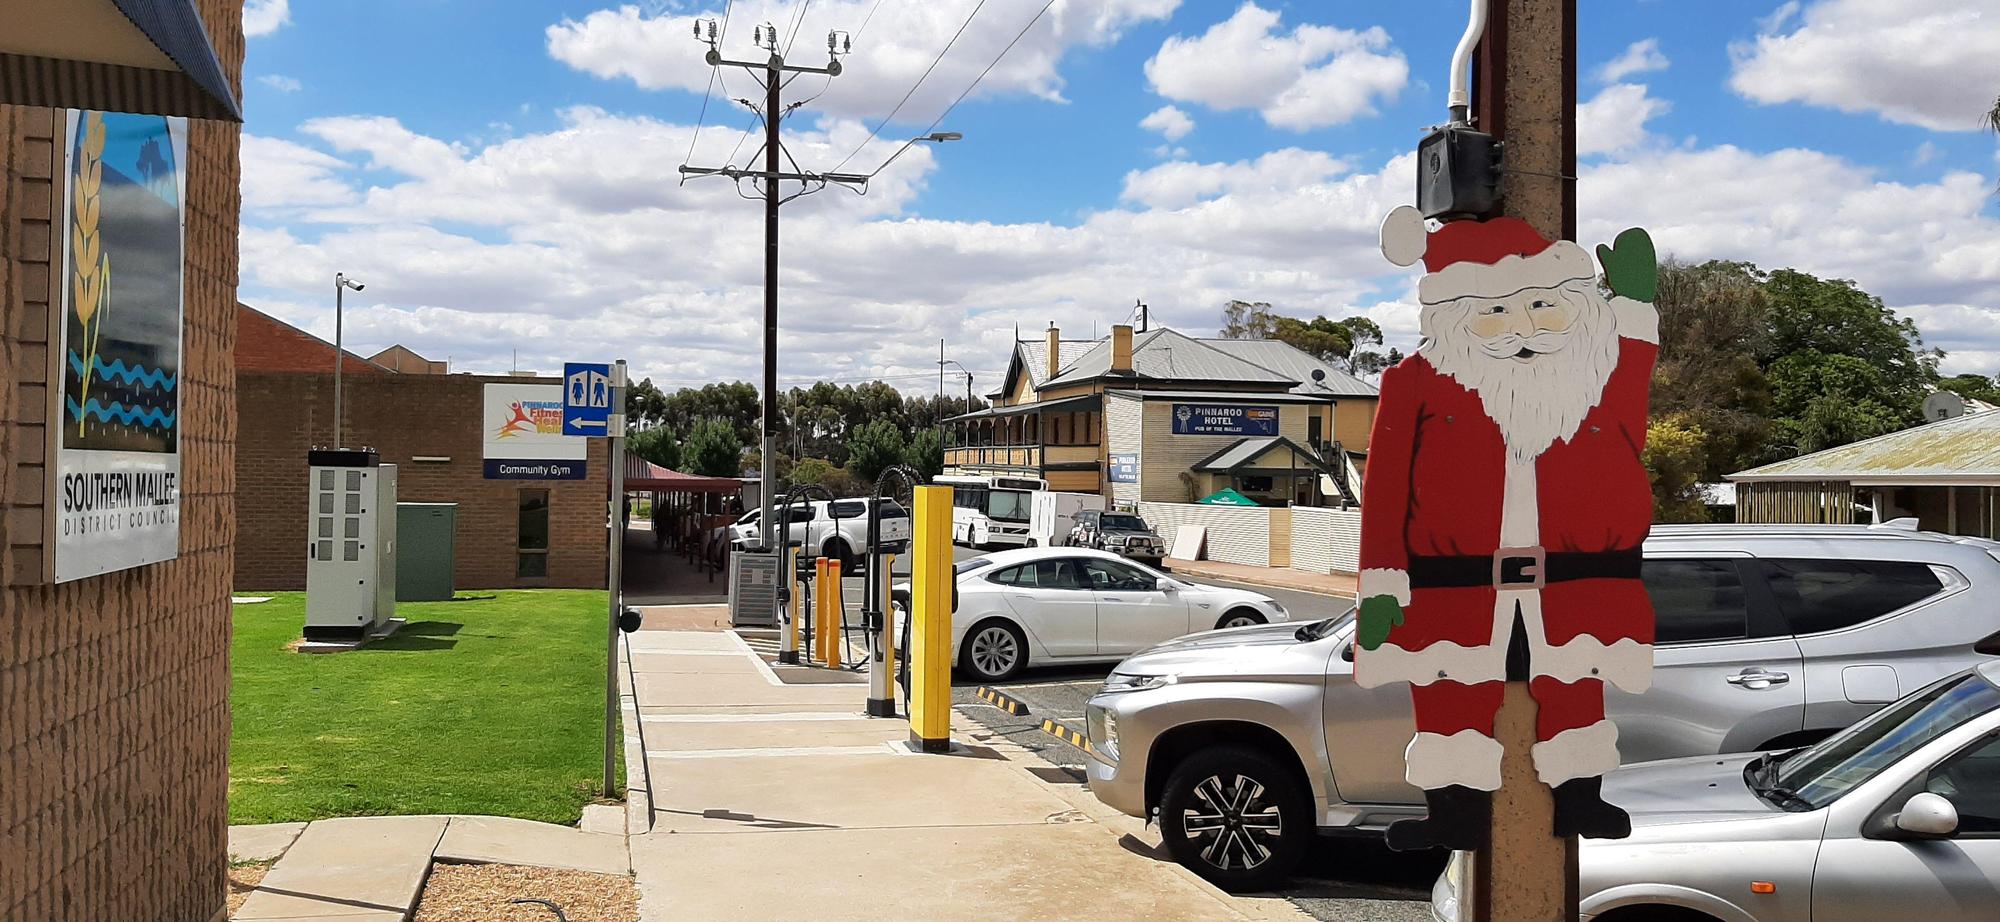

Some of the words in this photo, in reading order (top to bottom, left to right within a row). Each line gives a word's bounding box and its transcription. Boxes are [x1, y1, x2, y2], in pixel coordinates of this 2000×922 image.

[530, 408, 563, 417] Fitnes
[1195, 408, 1242, 416] PINNAROO
[534, 416, 562, 425] Heal
[1204, 417, 1233, 425] HOTEL
[500, 464, 549, 476] Community
[550, 465, 571, 476] Gym
[64, 472, 132, 513] SOUTHERN
[136, 472, 175, 507] MALLEE
[64, 513, 121, 536] DISTRICT
[129, 510, 175, 528] COUNCIL
